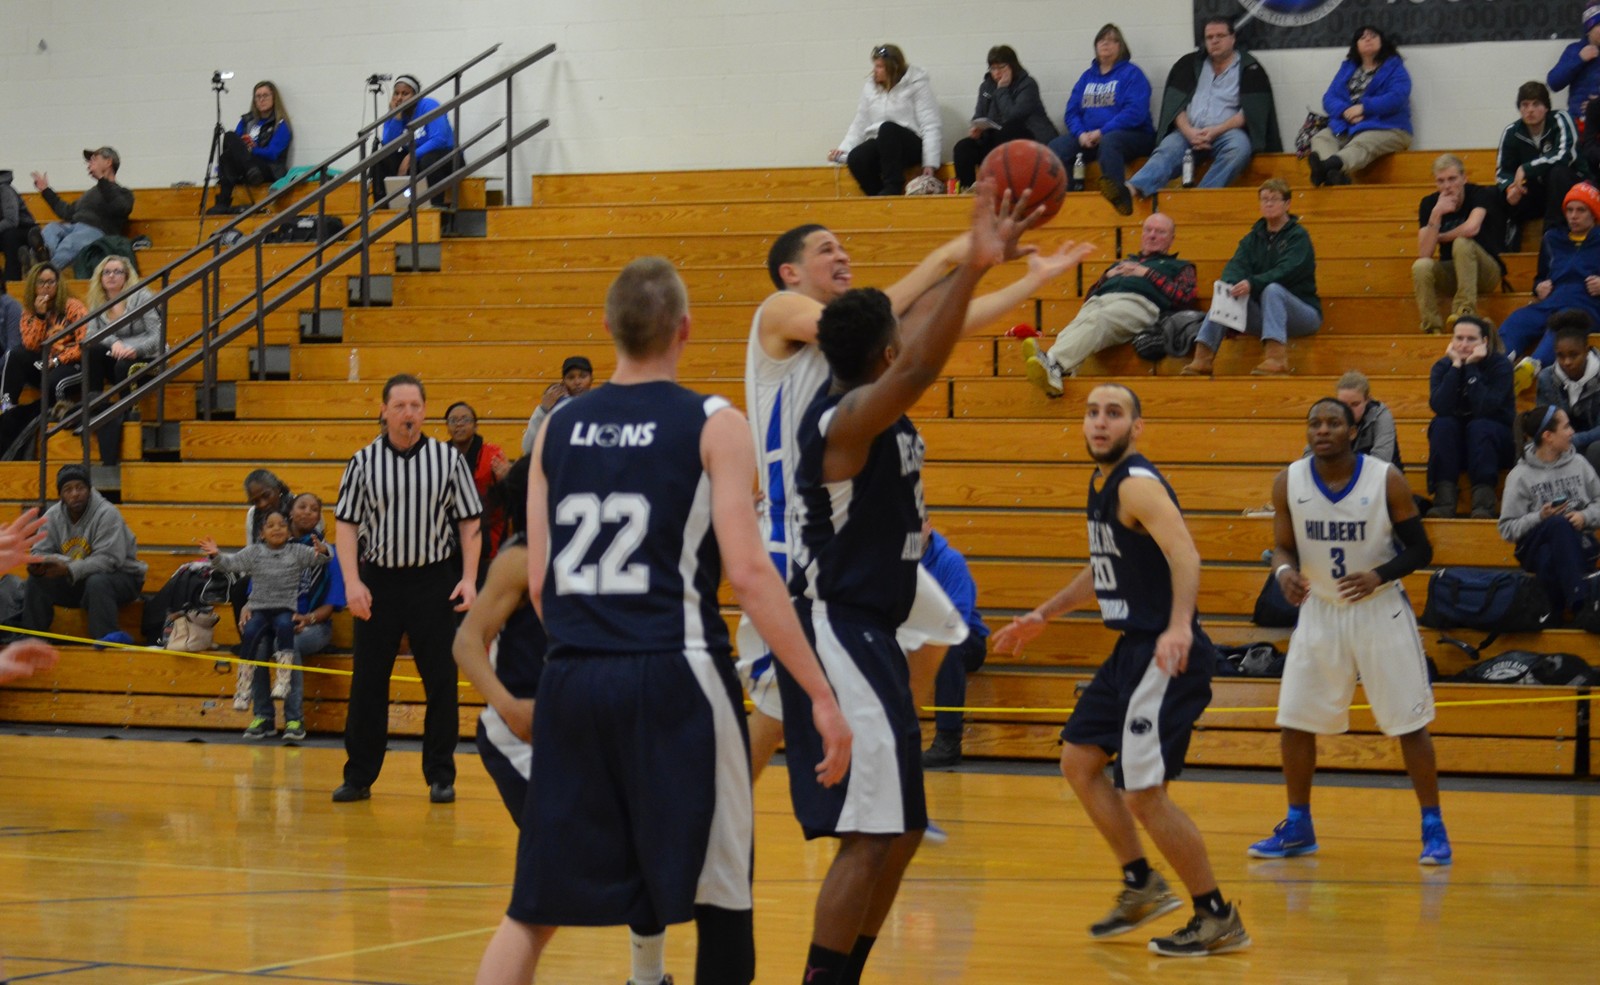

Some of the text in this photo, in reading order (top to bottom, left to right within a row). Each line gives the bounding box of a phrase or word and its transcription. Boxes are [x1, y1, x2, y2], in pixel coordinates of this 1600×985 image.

[552, 491, 652, 596] 22
[1305, 519, 1367, 542] HILBERT
[1330, 547, 1347, 579] 3
